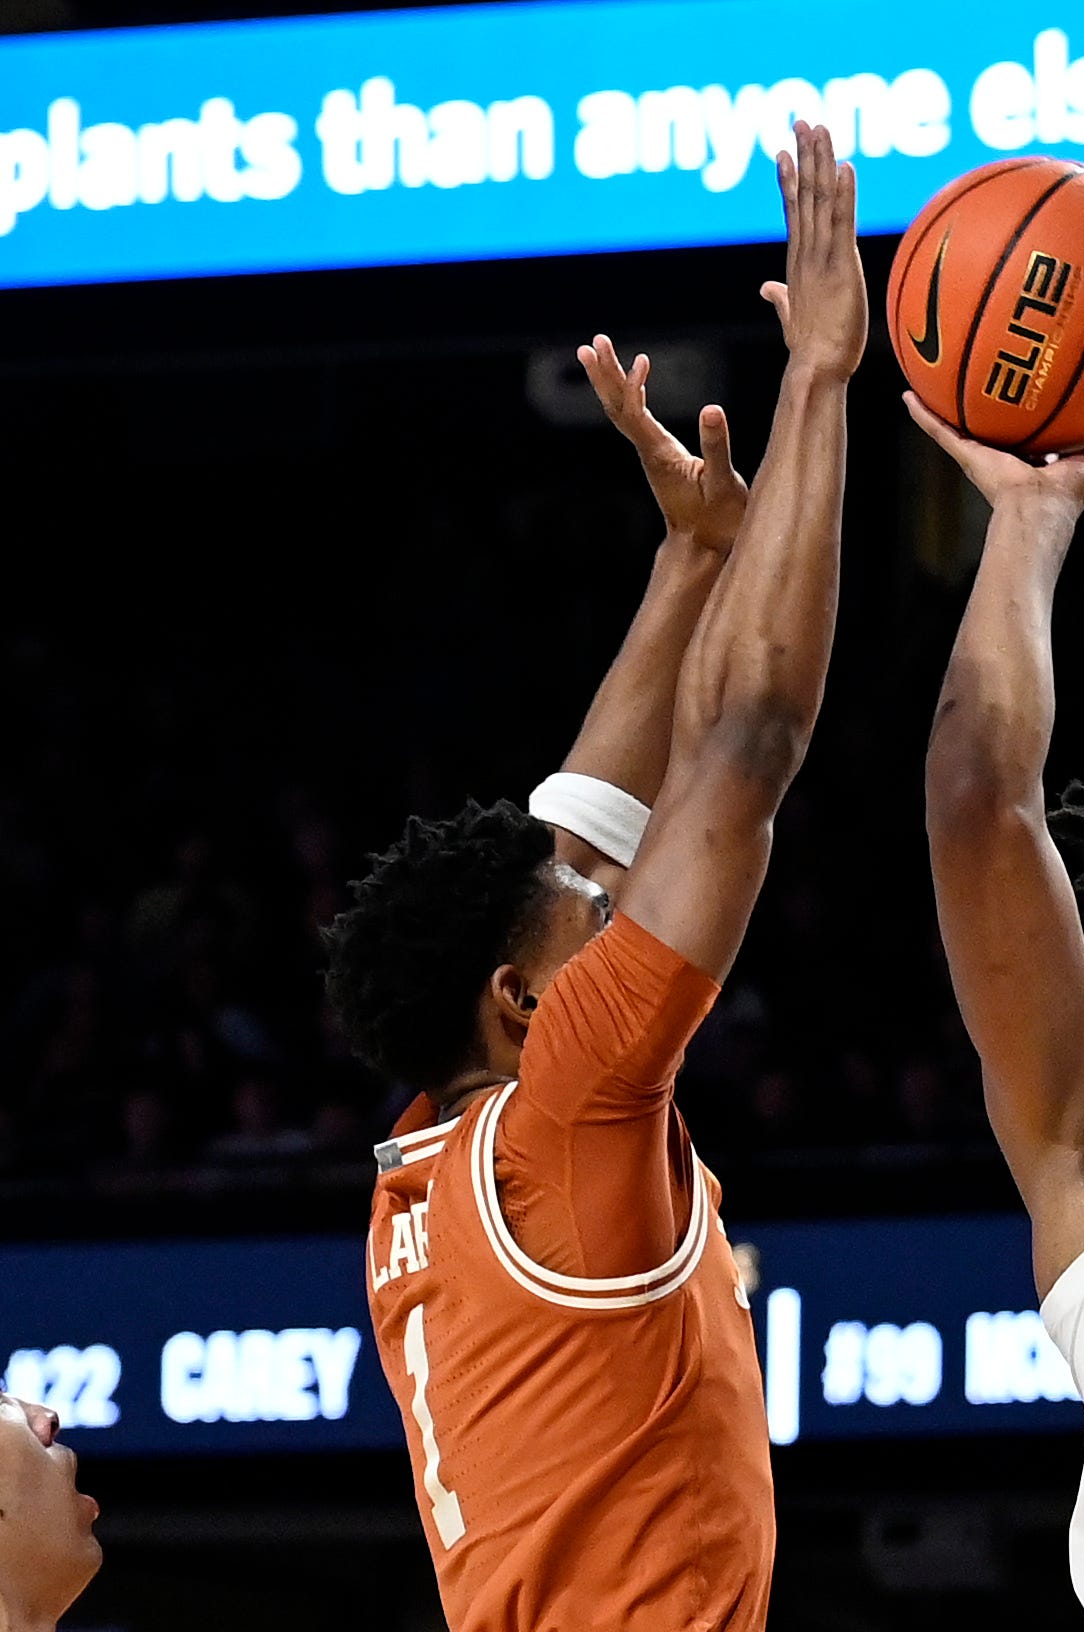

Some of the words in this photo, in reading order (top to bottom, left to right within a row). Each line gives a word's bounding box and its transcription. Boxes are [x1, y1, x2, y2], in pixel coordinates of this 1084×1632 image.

[0, 97, 303, 236] plants
[316, 76, 555, 195] than
[574, 68, 952, 192] anyone
[981, 250, 1072, 408] ELITE
[403, 1303, 467, 1551] 1
